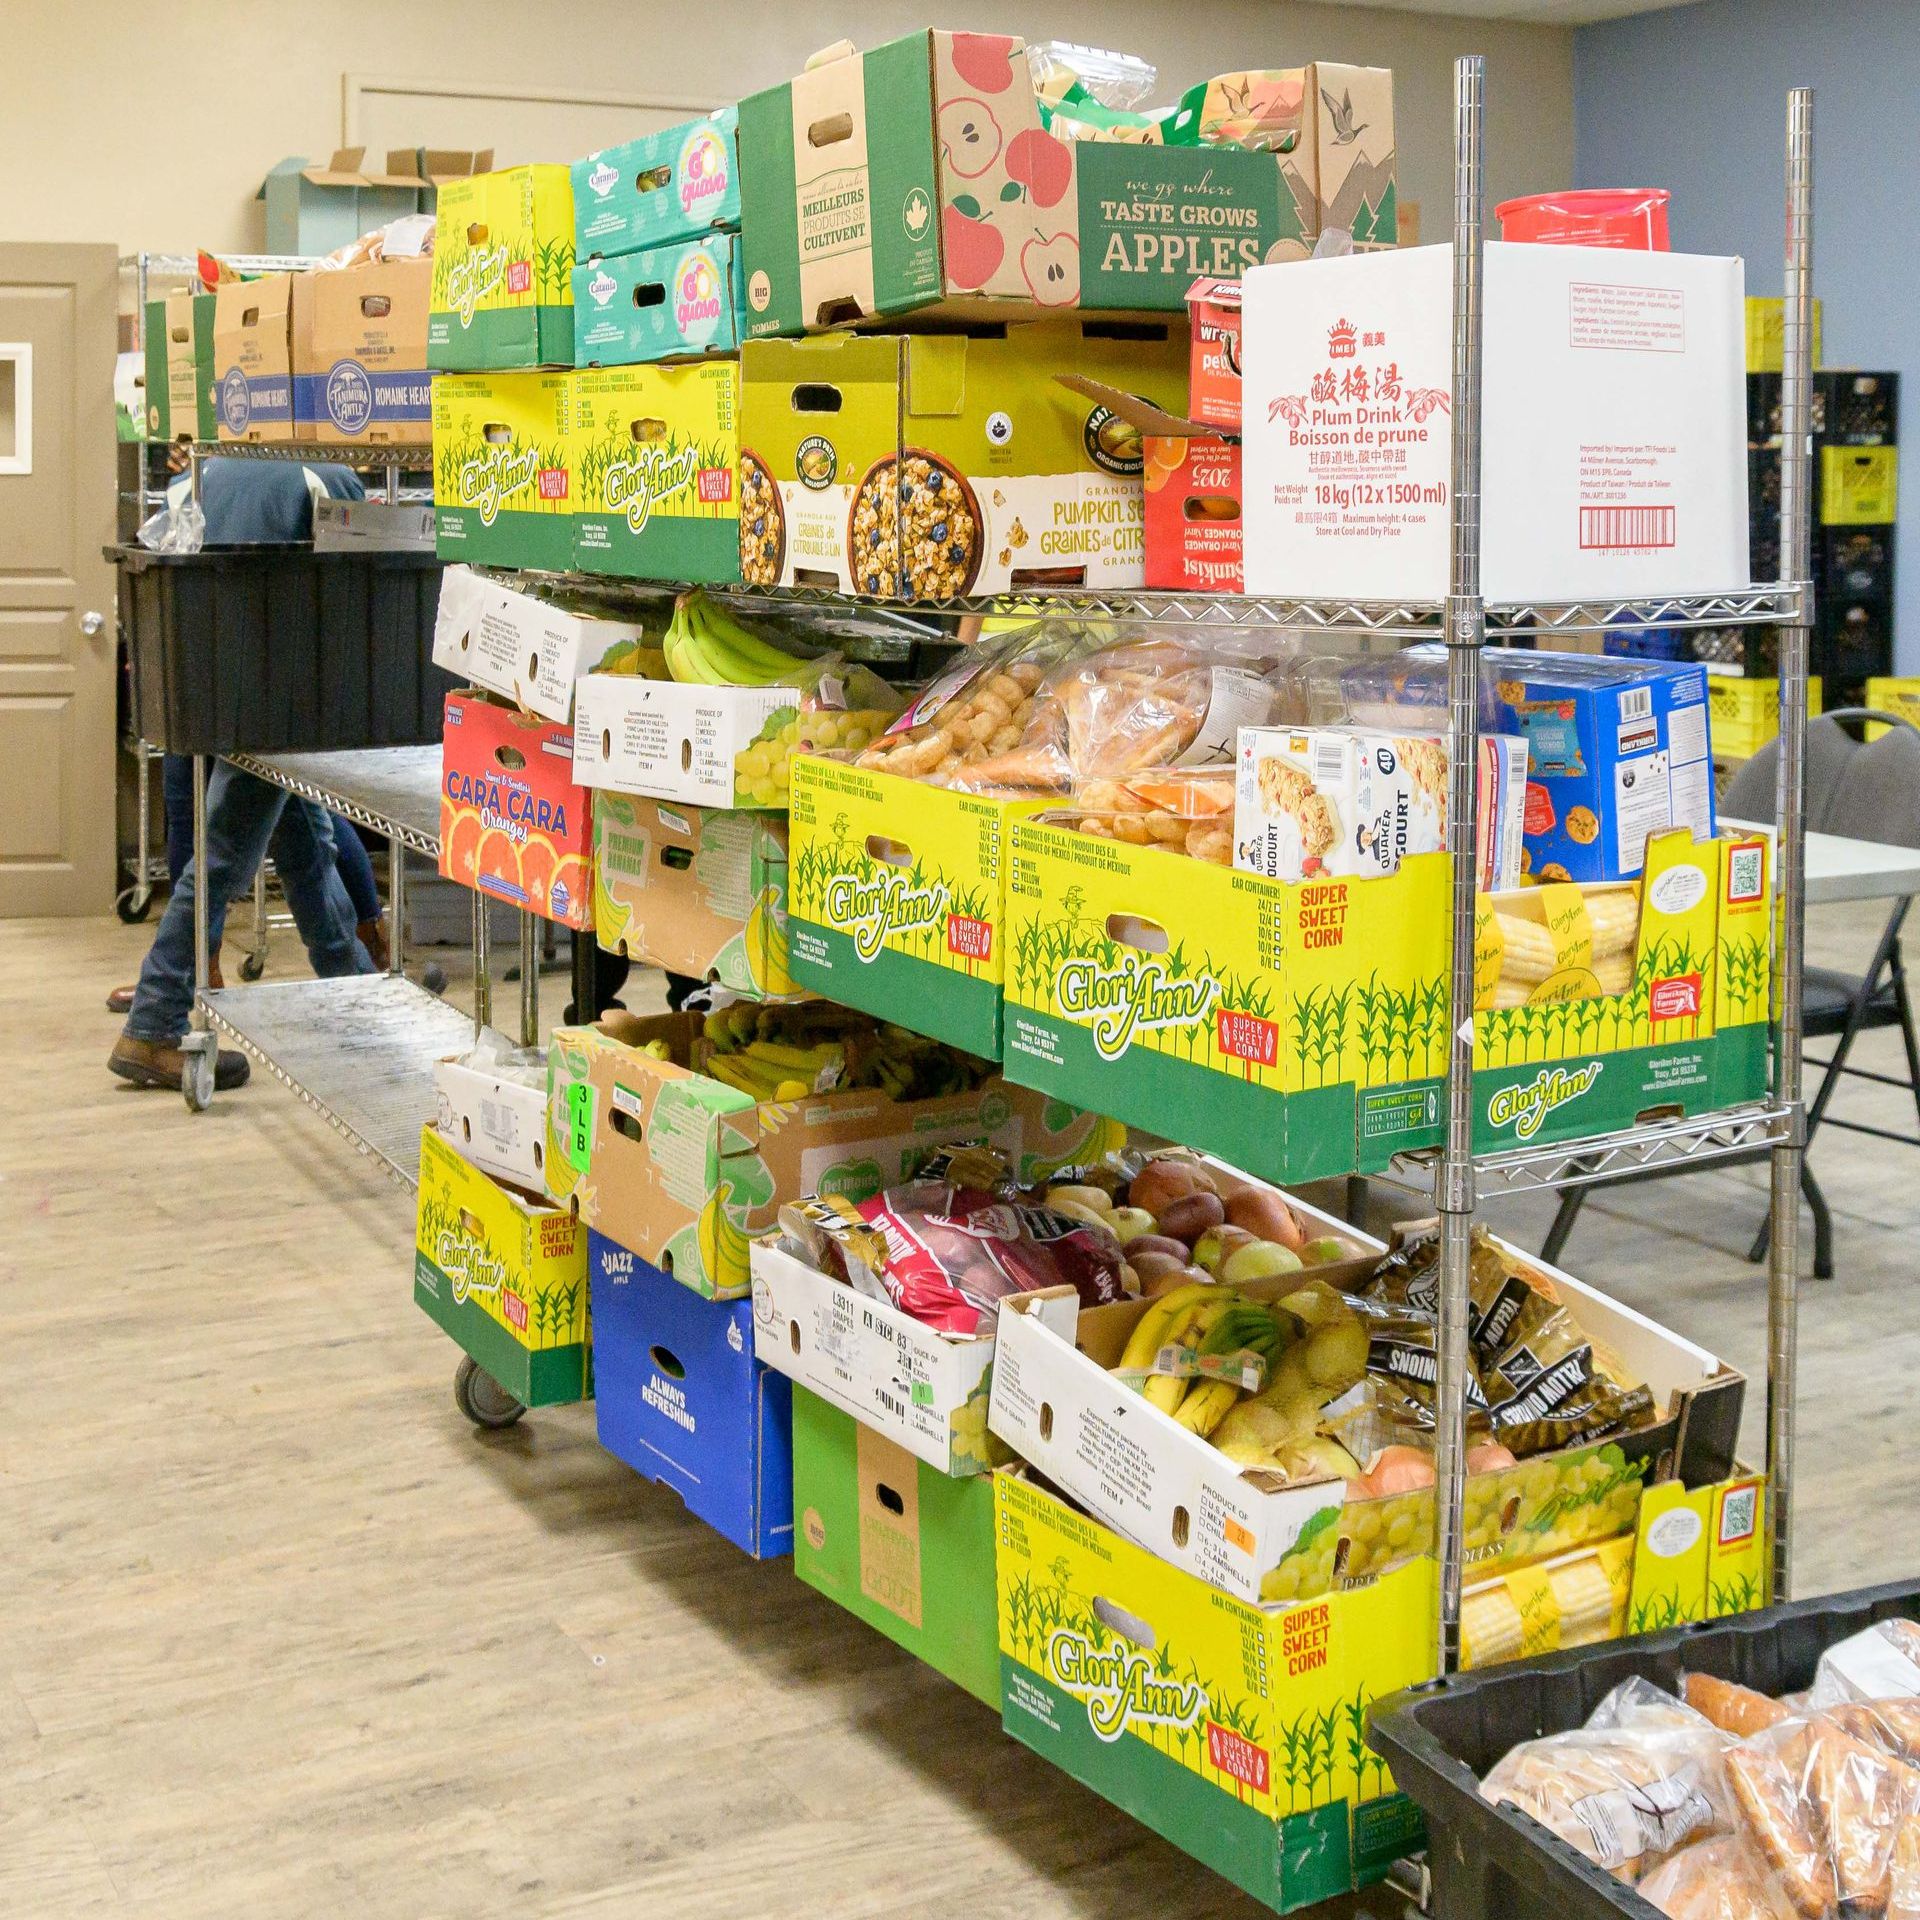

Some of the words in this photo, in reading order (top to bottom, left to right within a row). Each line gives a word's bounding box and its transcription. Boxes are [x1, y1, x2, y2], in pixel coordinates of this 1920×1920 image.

[682, 173, 727, 212] guava
[1125, 179, 1151, 191] we
[1154, 181, 1176, 199] go
[1183, 169, 1234, 196] where
[802, 188, 865, 219] MEILLEURS
[1101, 200, 1174, 224] TASTE
[1180, 205, 1258, 228] GROWS
[803, 210, 852, 235] PRODUITS
[853, 205, 865, 222] SE
[803, 222, 866, 251] CULTIVENT
[1101, 232, 1259, 280] APPLES
[754, 287, 768, 298] BIG
[677, 298, 720, 333] guava
[751, 319, 780, 335] POMMES
[1331, 343, 1355, 355] IMEI
[1362, 332, 1386, 347] 義美
[375, 387, 409, 406] ROMAINE
[410, 386, 432, 405] HEART
[1311, 362, 1404, 406] 酸梅湯
[1312, 409, 1352, 426] Plum
[1357, 406, 1402, 424] Drink
[1290, 430, 1350, 446] Boisson
[1354, 427, 1374, 443] de
[1378, 429, 1428, 447] prune
[462, 452, 534, 524] GloriAnn
[706, 472, 723, 482] SUPER
[1192, 464, 1232, 488] 2025
[606, 451, 692, 529] GloriAnn
[1086, 486, 1143, 496] GRANOLA
[1275, 484, 1285, 493] Net
[1286, 484, 1308, 495] Weight
[1275, 495, 1290, 504] Poids
[1292, 496, 1302, 504] net
[1315, 485, 1331, 504] 18
[1333, 484, 1349, 509] kg
[1352, 484, 1373, 506] (12
[1375, 488, 1384, 503] x
[1387, 484, 1421, 503] 1500
[1423, 482, 1447, 506] ml)
[1342, 514, 1375, 523] Maximum
[1377, 512, 1400, 525] height:
[1401, 513, 1407, 522] 4
[1408, 514, 1426, 523] cases
[1205, 528, 1242, 539] ORANGES
[1316, 527, 1332, 536] Store
[1341, 527, 1355, 535] Cool
[1357, 527, 1368, 535] and
[1370, 527, 1381, 537] Dry
[1383, 527, 1401, 535] Place
[1185, 540, 1220, 550] ORANGES
[1183, 557, 1244, 584] Sunkist
[696, 709, 716, 717] PRODUCE
[1382, 752, 1394, 773] 40
[447, 770, 501, 816] CARA
[507, 790, 568, 838] CARA
[959, 801, 968, 812] EAR
[969, 803, 998, 818] CONTAINERS
[480, 807, 529, 844] Oranges
[1021, 827, 1042, 842] PRODUCE
[1044, 832, 1050, 841] OF
[1052, 834, 1068, 847] U.S.A.
[1072, 838, 1094, 853] PRODUIT
[1096, 844, 1105, 856] DES
[1381, 808, 1392, 869] QUAKER
[1021, 839, 1042, 855] PRODUCE
[1044, 846, 1050, 856] OF
[1051, 845, 1070, 862] MEXICO
[1075, 853, 1098, 869] PRODUIT
[1099, 859, 1106, 870] DE
[1107, 859, 1131, 876] MEXIQUE
[1256, 834, 1264, 872] QUAKER
[1021, 860, 1036, 872] WHITE
[1021, 872, 1040, 886] YELLOW
[1232, 877, 1243, 890] EAR
[1244, 879, 1281, 900] CONTAINERS
[1027, 886, 1043, 899] COLOR
[1300, 883, 1348, 907] SUPER
[829, 873, 942, 958] GloriAnn
[1257, 898, 1272, 912] 24/2
[958, 919, 982, 935] SUPER
[1258, 912, 1272, 927] 12/4
[1299, 905, 1349, 930] SWEET
[958, 928, 982, 947] SWEET
[1257, 926, 1272, 941] 10/6
[1303, 926, 1343, 951] CORN
[960, 940, 980, 957] CORN
[1257, 940, 1272, 956] 10/8
[1260, 955, 1272, 970] 8/8
[1059, 957, 1210, 1055] GloriAnn
[1232, 1016, 1263, 1036] SUPER
[1232, 1028, 1263, 1048] SWEET
[1234, 1041, 1261, 1060] CORN
[578, 1085, 588, 1103] 3
[1491, 1066, 1598, 1137] GloriAnn
[541, 1214, 578, 1232] SUPER
[540, 1230, 577, 1246] SWEET
[543, 1244, 574, 1260] CORN
[603, 1251, 634, 1275] JAZZ
[438, 1234, 502, 1304] GloriAnn
[832, 1290, 854, 1316] L3311
[832, 1308, 854, 1329] GRAPES
[865, 1311, 872, 1328] A
[897, 1332, 907, 1350] 83
[1485, 1297, 1521, 1349] YELLOW
[1388, 1349, 1436, 1382] NIONS
[650, 1374, 686, 1409] ALWAYS
[1538, 1360, 1587, 1408] YELLOW
[641, 1385, 696, 1433] REFRESHING
[1079, 1412, 1116, 1444] AGRICULTURA
[1116, 1440, 1126, 1451] DO
[1126, 1447, 1140, 1462] VALE
[1141, 1459, 1156, 1473] LTDA
[1100, 1482, 1118, 1502] ITEM
[1202, 1483, 1237, 1514] PRODUCE
[1238, 1509, 1249, 1521] OF
[1203, 1546, 1251, 1589] CLAMSHELLS
[1211, 1593, 1222, 1608] EAR
[1223, 1598, 1263, 1628] CONTAINERS
[1283, 1604, 1329, 1635] SUPER
[1282, 1625, 1330, 1657] SWEET
[1288, 1647, 1328, 1677] CORN
[1050, 1636, 1197, 1737] GloriAnn
[1222, 1732, 1253, 1756] SUPER
[1222, 1747, 1253, 1770] SWEET
[1225, 1761, 1252, 1783] CORN
